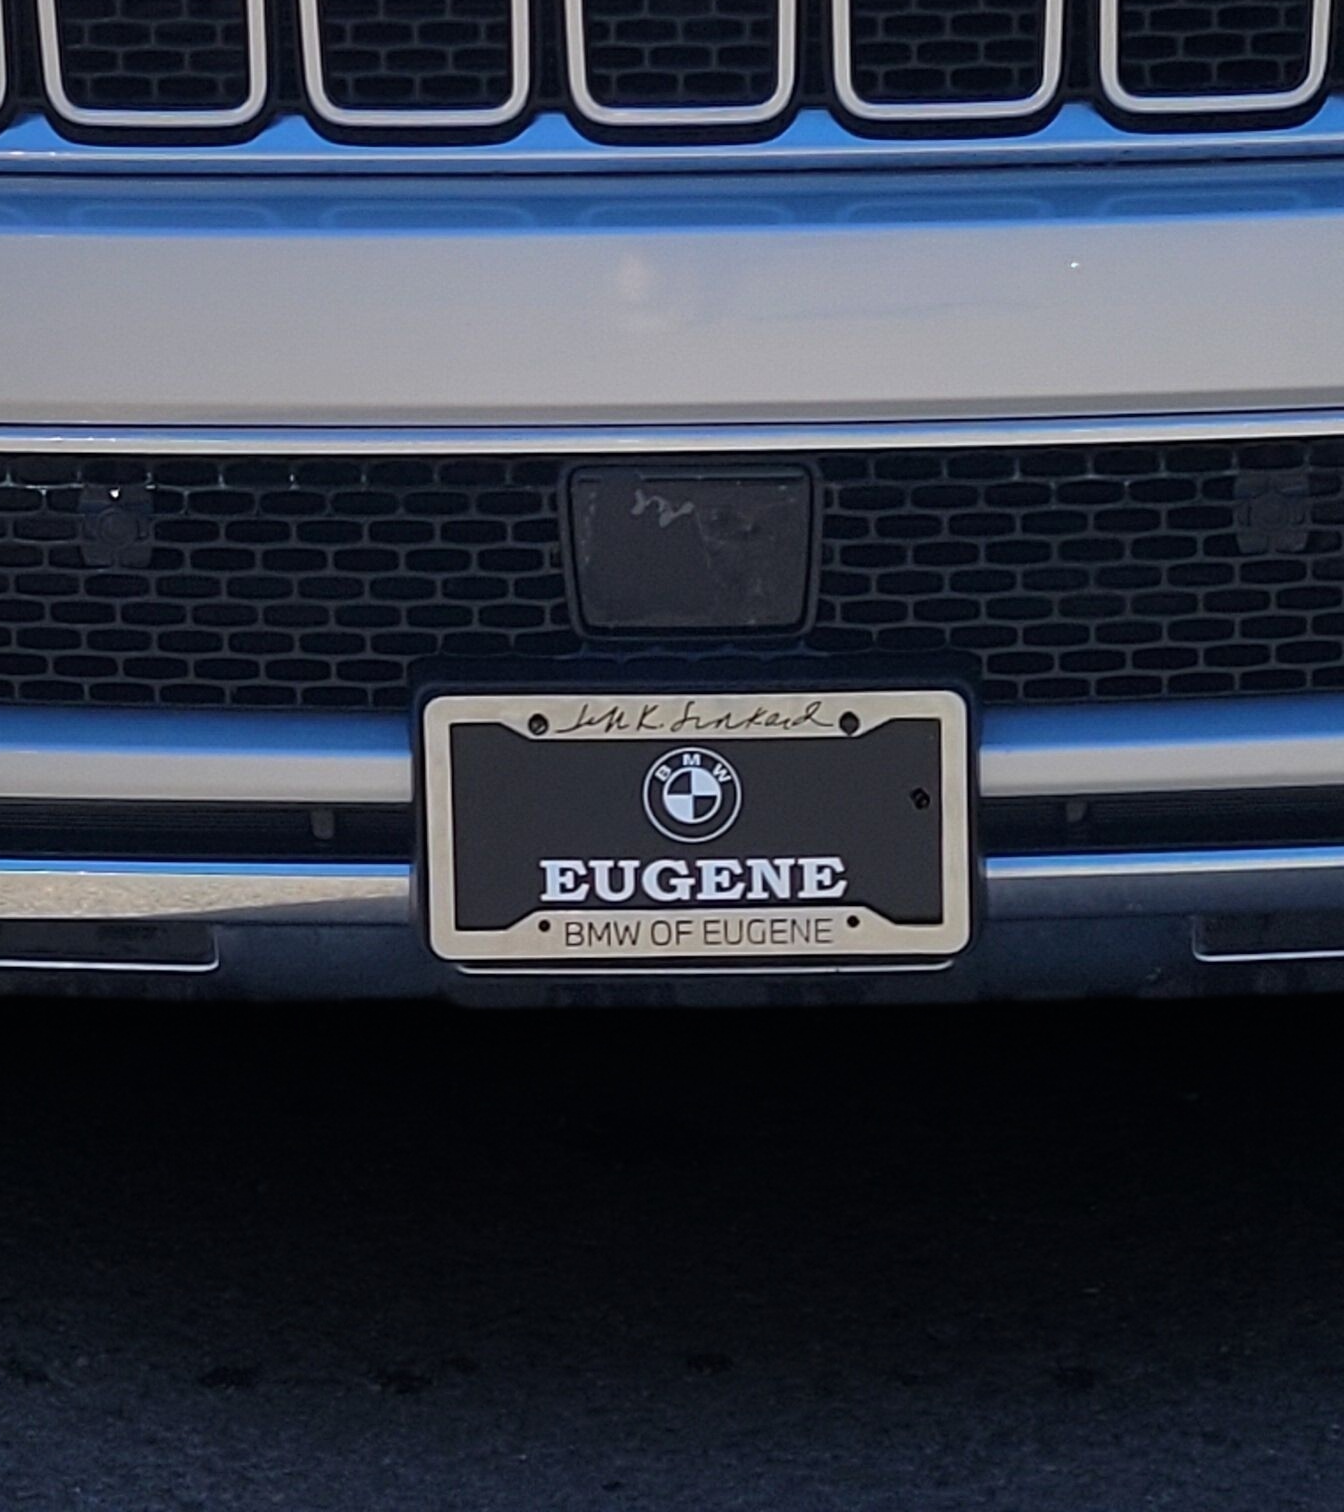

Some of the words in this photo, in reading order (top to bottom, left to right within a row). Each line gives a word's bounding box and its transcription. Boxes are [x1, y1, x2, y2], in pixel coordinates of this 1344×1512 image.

[654, 752, 732, 784] BMW
[539, 856, 848, 902] EUGENE
[564, 919, 641, 948] BMW
[650, 918, 693, 947] OF
[702, 917, 834, 946] EUGENE
